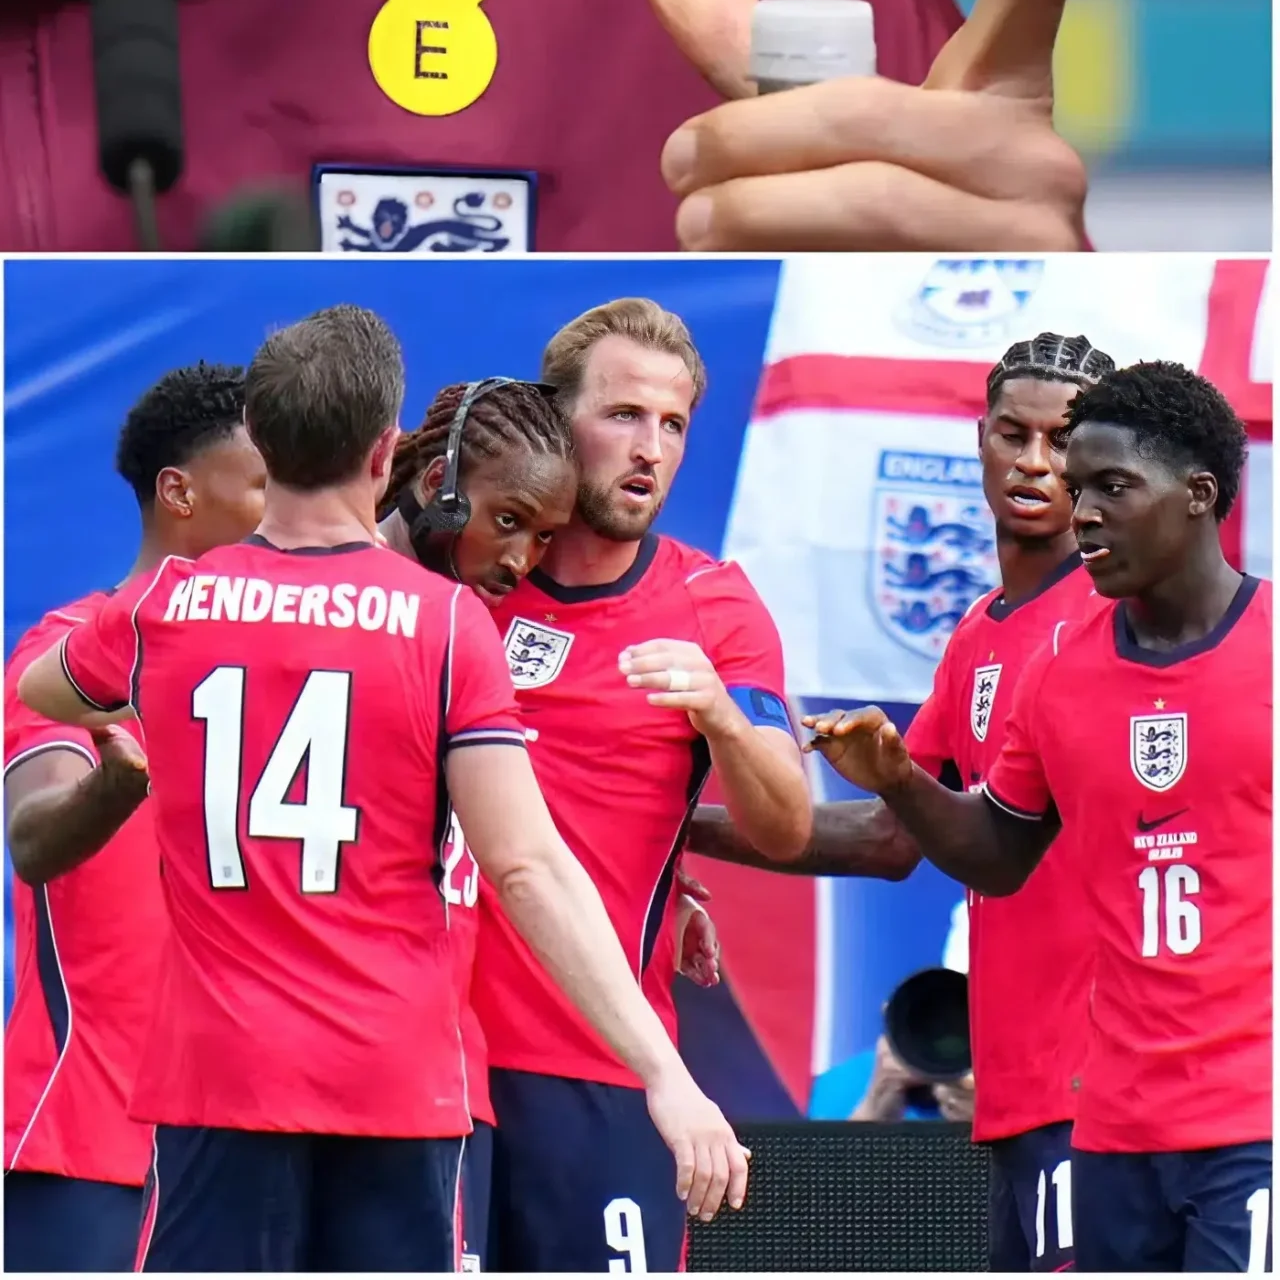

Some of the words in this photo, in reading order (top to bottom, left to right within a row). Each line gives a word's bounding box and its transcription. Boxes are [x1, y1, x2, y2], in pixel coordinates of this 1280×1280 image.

[882, 453, 983, 485] ENGLAN
[163, 575, 420, 639] HENDERSON
[191, 665, 361, 893] 14
[1138, 864, 1202, 958] 16
[603, 1197, 648, 1272] 9
[1036, 1159, 1074, 1258] 11
